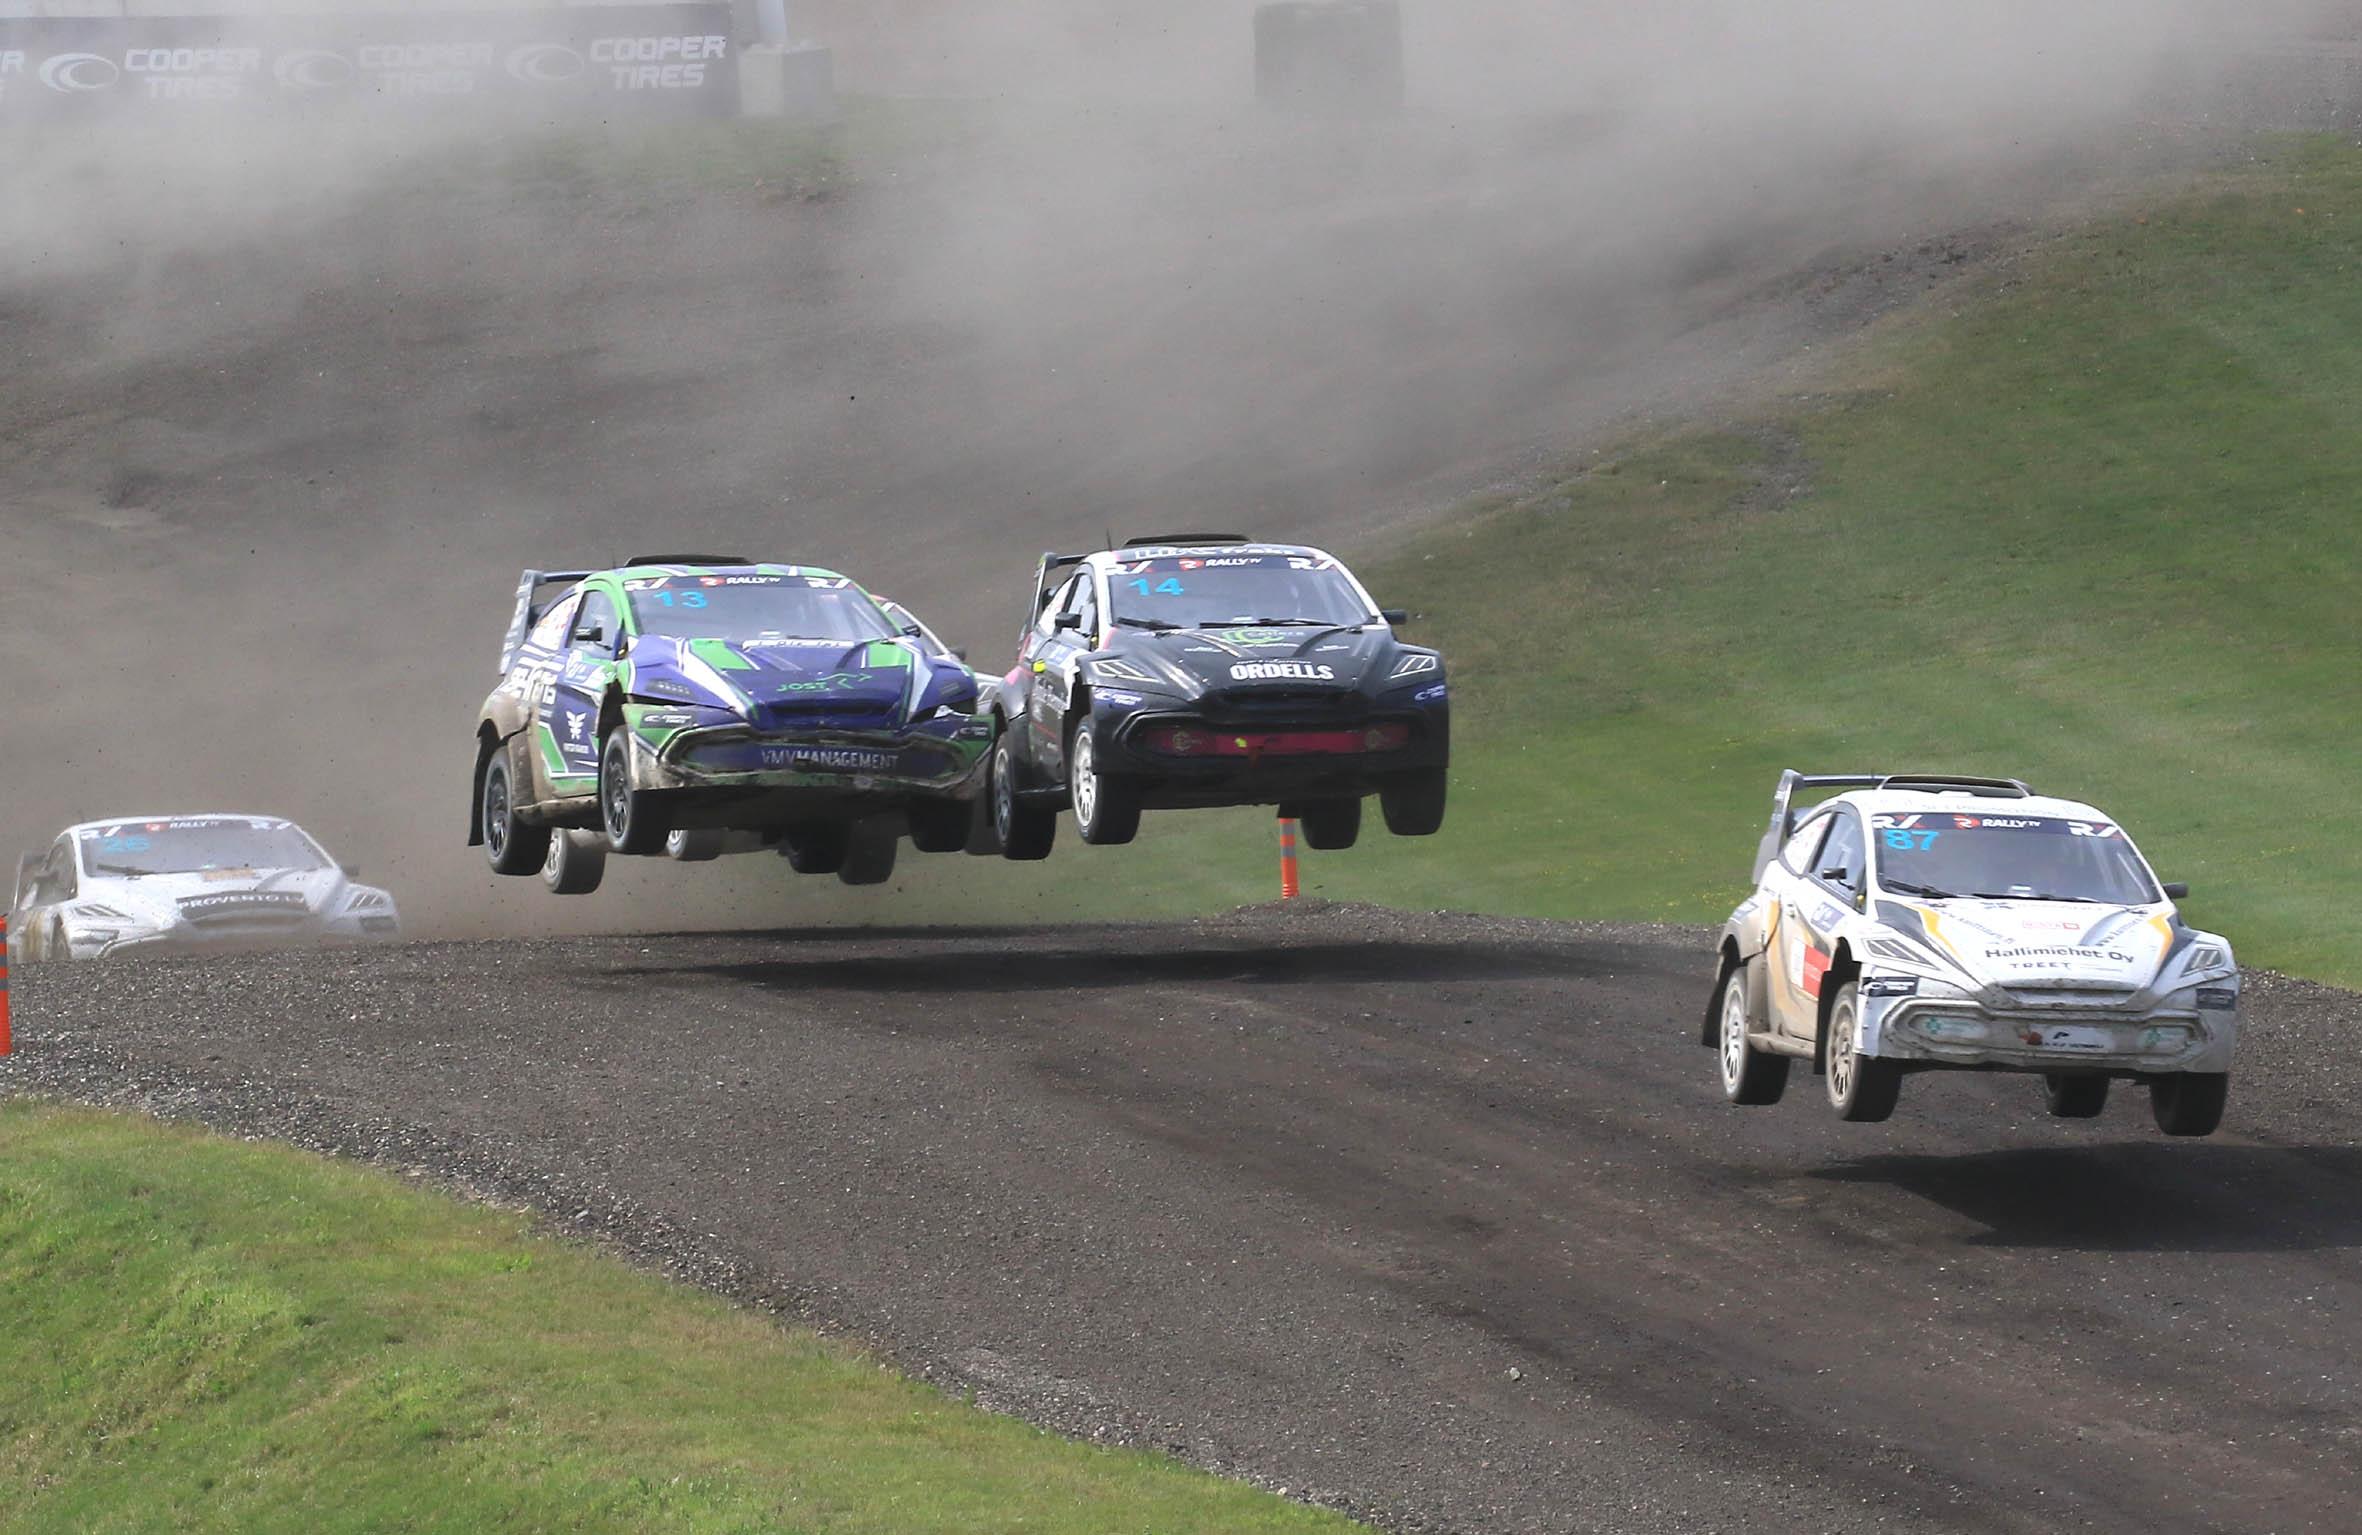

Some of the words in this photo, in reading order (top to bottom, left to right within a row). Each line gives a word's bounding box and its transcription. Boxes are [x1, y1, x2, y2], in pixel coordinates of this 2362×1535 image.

[590, 36, 727, 62] COOPER
[125, 49, 261, 72] COOPER
[610, 64, 706, 89] TIRES
[1128, 577, 1185, 597] 14
[653, 591, 708, 609] 13
[1229, 662, 1335, 681] ORDELLS
[1883, 829, 1940, 851] 87
